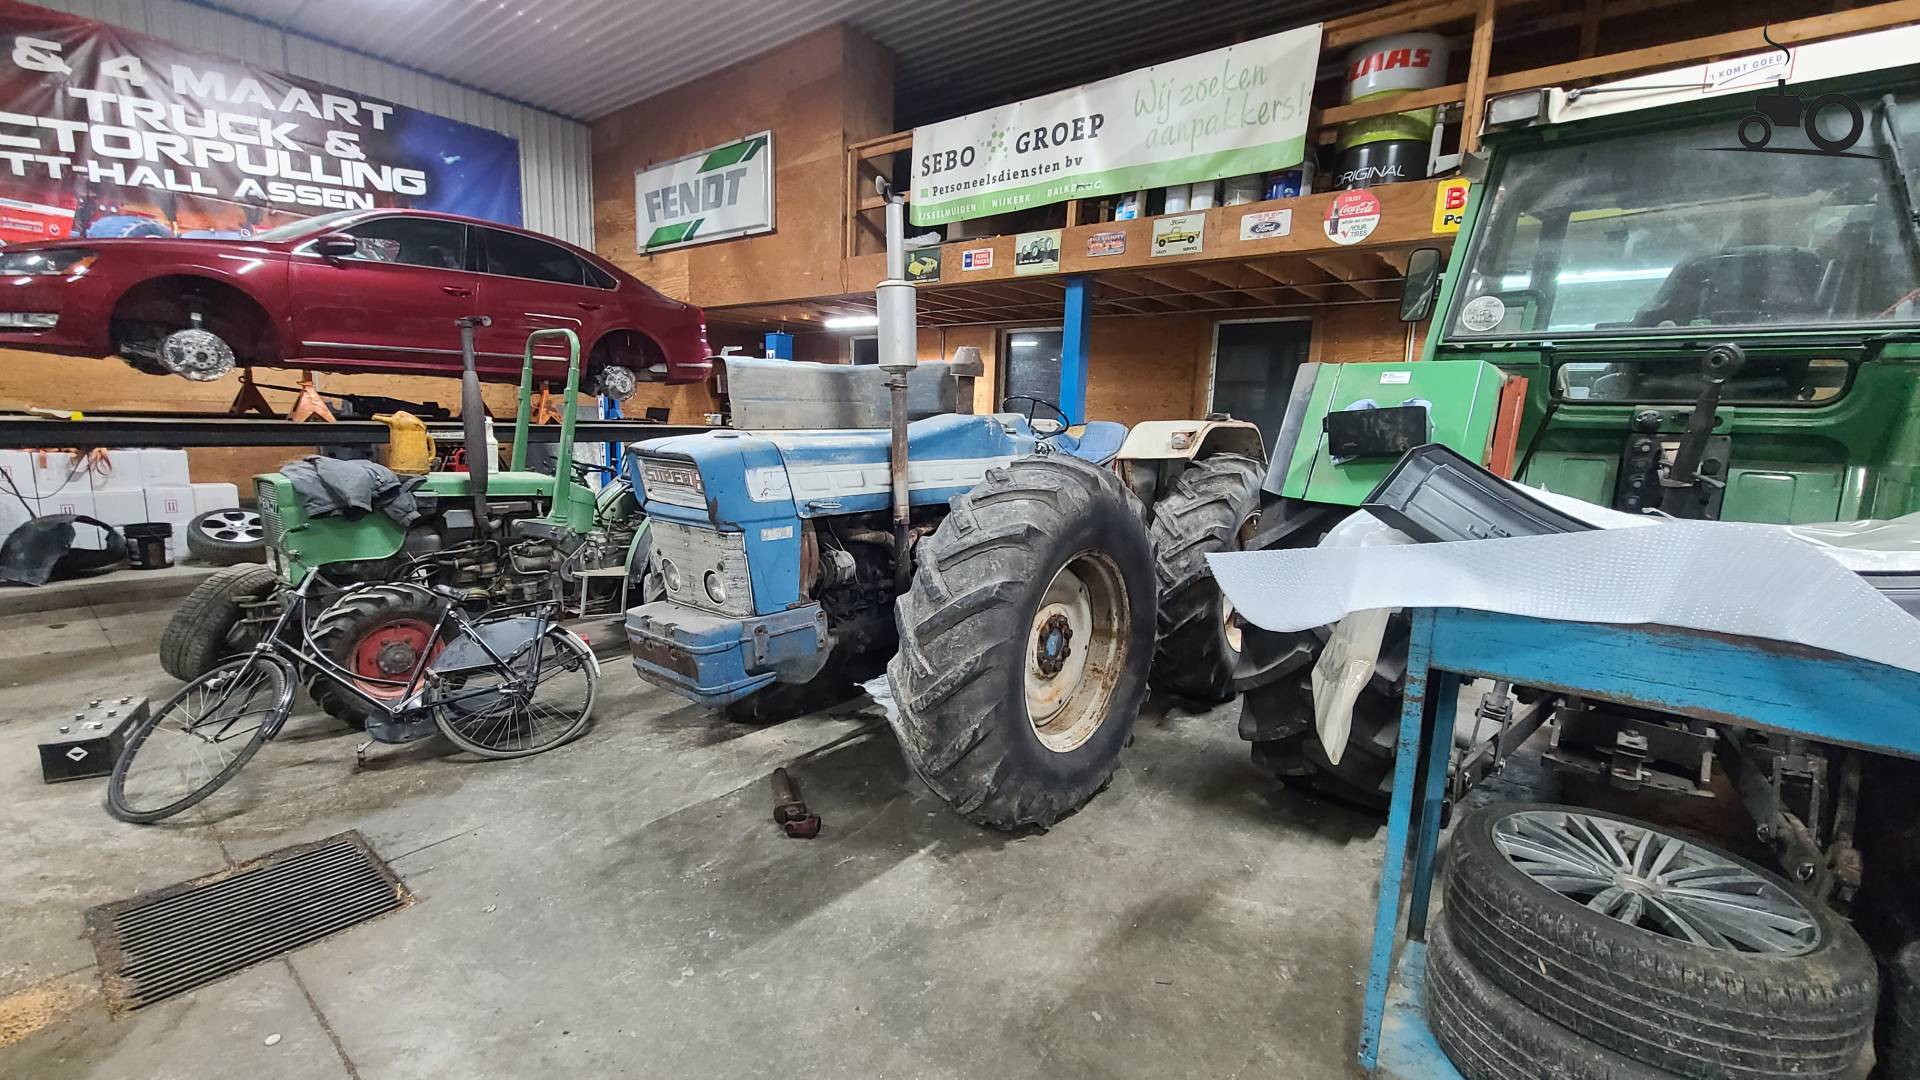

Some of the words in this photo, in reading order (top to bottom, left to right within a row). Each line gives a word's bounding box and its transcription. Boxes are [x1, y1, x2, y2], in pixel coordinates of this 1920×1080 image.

[12, 36, 72, 76] &
[101, 55, 146, 87] 4
[172, 64, 393, 131] MAART
[1718, 64, 1748, 79] KOMT
[1752, 54, 1783, 69] GOED
[1134, 78, 1175, 125] Wij
[1180, 58, 1268, 107] zoeken
[68, 87, 304, 152] TRUCK
[324, 130, 367, 161] &
[1145, 82, 1306, 152] aanpakkers!
[921, 146, 976, 177] SEBO
[1015, 113, 1104, 154] GROEP
[0, 150, 218, 195] TT-HALL
[234, 178, 375, 210] ASSEN
[645, 167, 748, 223] FENDT
[932, 161, 1061, 197] Personeelsdiensten
[1065, 154, 1083, 170] bv
[1335, 165, 1405, 187] ORIGINAL
[991, 193, 1032, 208] NIJKERK
[1255, 222, 1276, 233] Ford
[1350, 223, 1367, 231] YOUR
[1350, 230, 1368, 238] TIRES
[646, 469, 693, 487] SUPER
